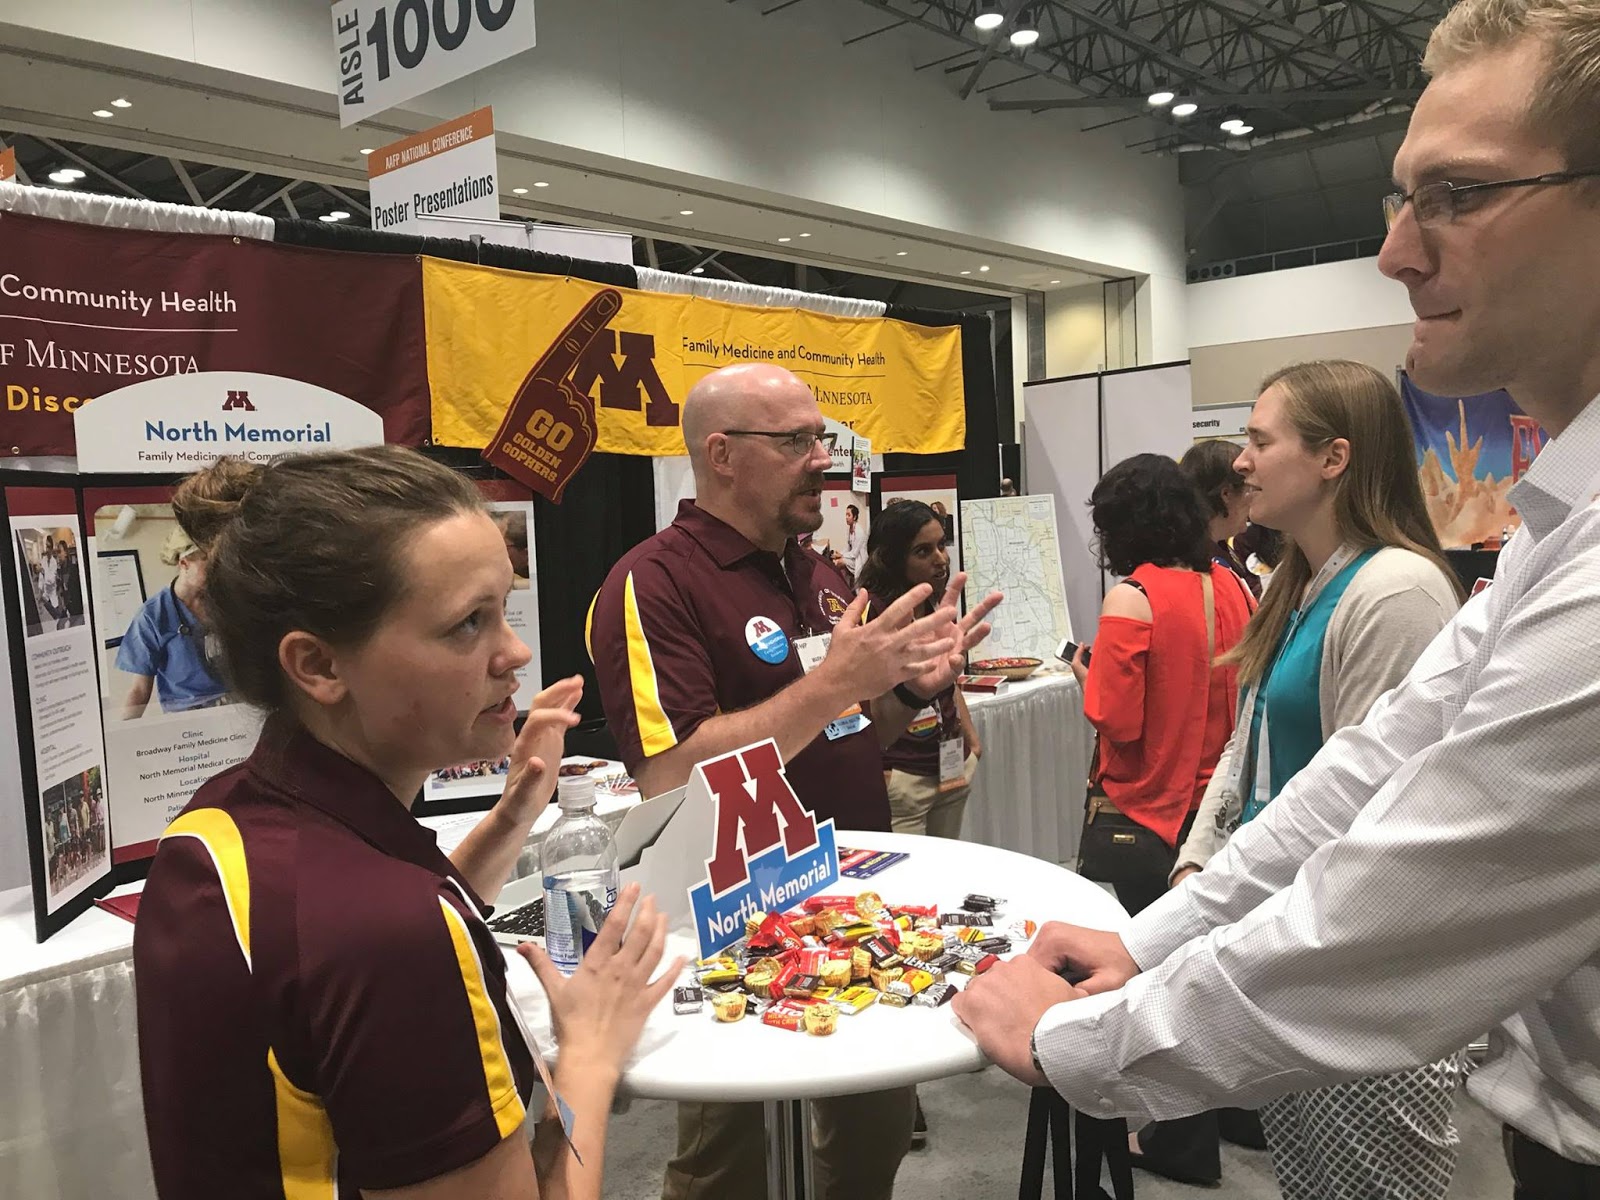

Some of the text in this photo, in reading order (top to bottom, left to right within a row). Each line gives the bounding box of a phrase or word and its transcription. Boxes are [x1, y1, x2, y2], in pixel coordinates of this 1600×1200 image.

[338, 8, 364, 105] AISLE
[385, 125, 473, 170] AAFP NATIONAL CONFERENCE
[374, 174, 494, 230] Poster Presentations
[0, 273, 237, 317] Community Health
[25, 338, 200, 376] MINNESOTA
[682, 336, 886, 368] Family Medicine and Community Health
[6, 384, 95, 413] Disc
[221, 390, 257, 412] M
[145, 420, 331, 443] North Memorial
[525, 408, 575, 452] GO
[1192, 419, 1220, 428] security
[138, 451, 173, 463] Family
[176, 451, 223, 461] Medicin
[227, 451, 245, 461] nd
[502, 442, 558, 482] GOPHERS
[512, 432, 562, 469] GOLDEN
[136, 733, 247, 757] Broadway Family Medicine Clinic
[181, 731, 204, 739] Clinic
[139, 756, 248, 781] North Memorial Medical Center
[178, 751, 210, 763] Hospital
[143, 788, 199, 804] North Minneap
[701, 741, 818, 896] M
[707, 893, 758, 944] North
[760, 851, 831, 913] Memorial
